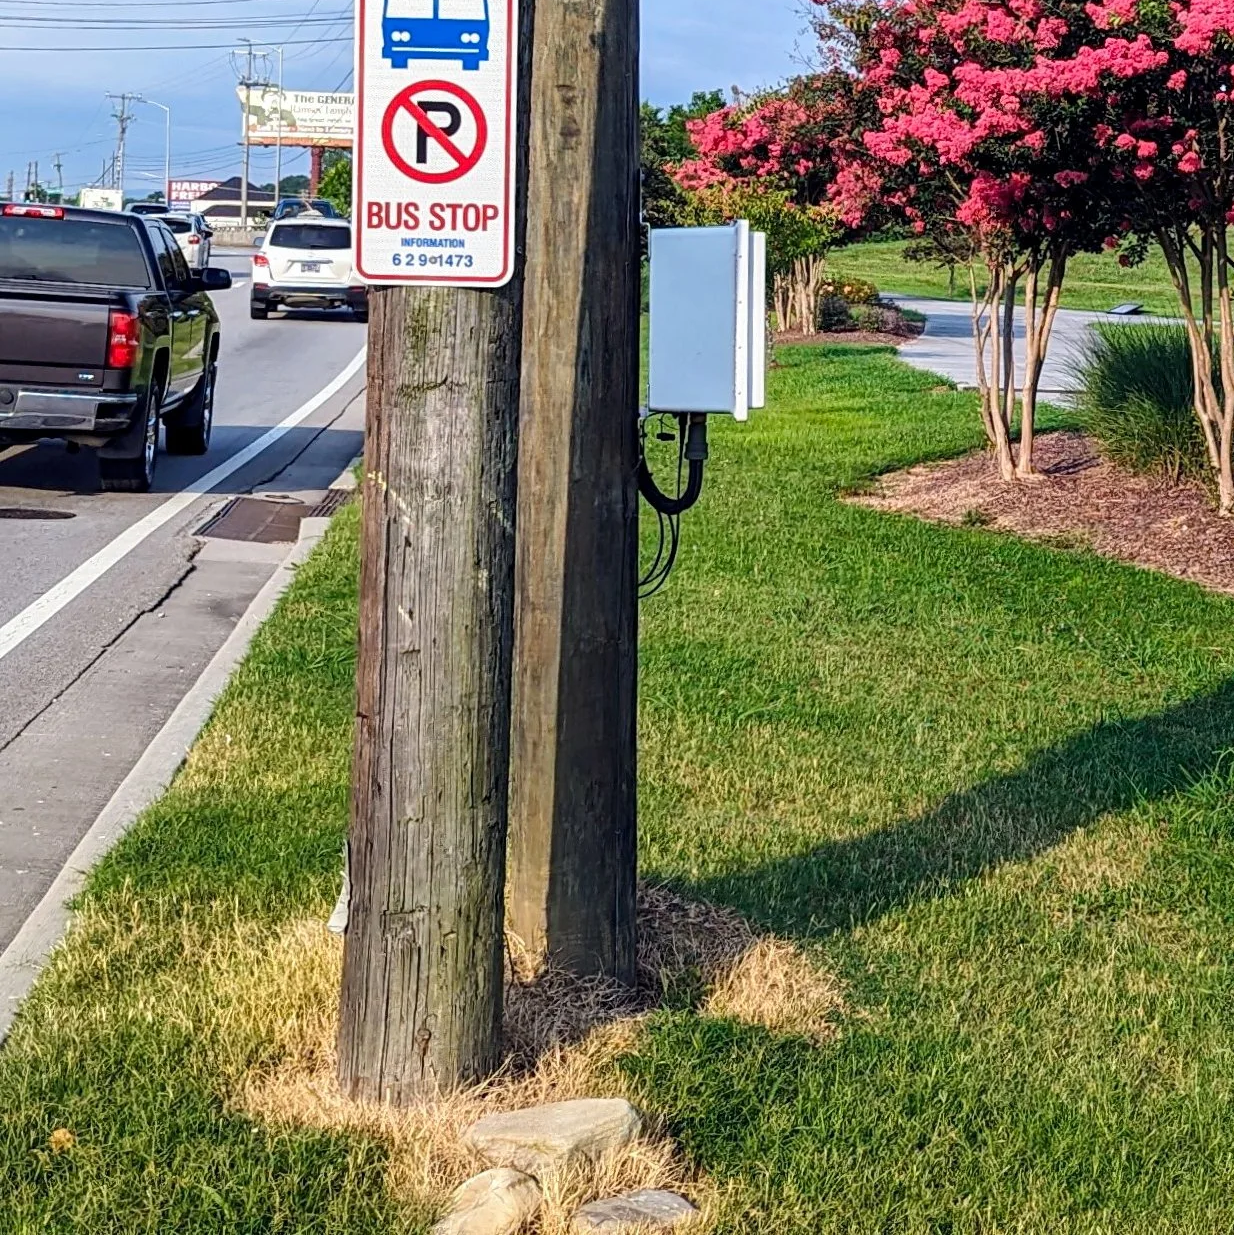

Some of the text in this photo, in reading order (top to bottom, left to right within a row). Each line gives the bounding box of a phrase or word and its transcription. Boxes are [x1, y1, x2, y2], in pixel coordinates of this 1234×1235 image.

[294, 94, 315, 104] The
[367, 201, 499, 232] BUS STOP
[401, 237, 465, 248] INFORMATION
